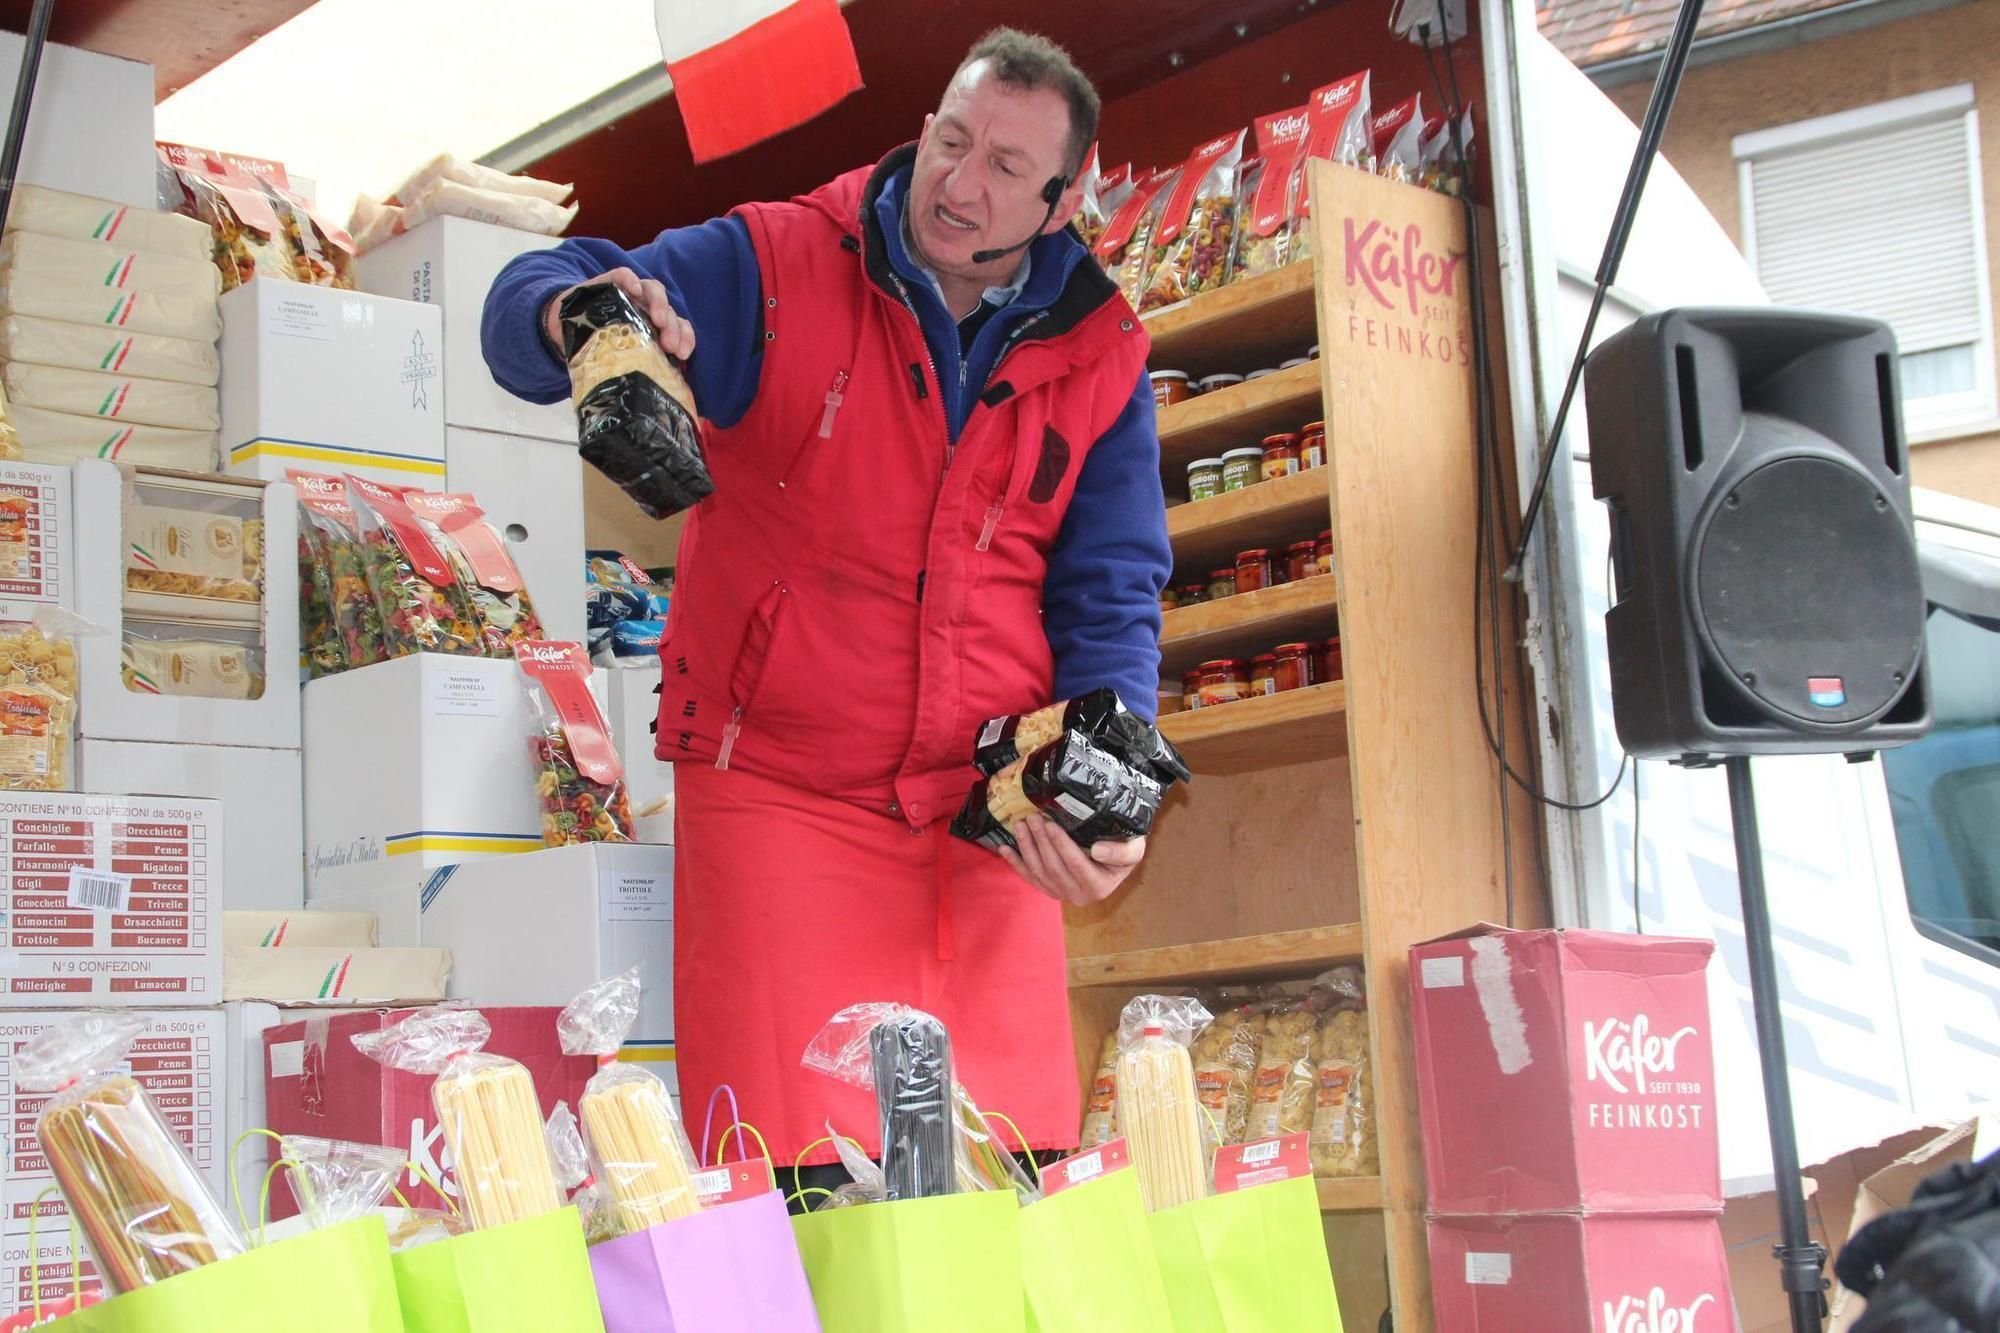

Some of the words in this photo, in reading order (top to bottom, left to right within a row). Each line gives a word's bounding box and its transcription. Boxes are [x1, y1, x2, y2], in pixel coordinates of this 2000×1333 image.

[1344, 216, 1469, 317] Käfer
[1425, 305, 1450, 322] SEIT
[1349, 315, 1470, 367] FEINKOS
[0, 583, 37, 593] ucaneve
[532, 645, 567, 664] Käfer
[0, 802, 54, 815] CONTIENE
[85, 806, 150, 818] CONFEZIONI
[153, 808, 165, 818] da
[16, 822, 72, 835] Conchiglie
[127, 826, 183, 837] Orecchiette
[16, 841, 57, 851] Farfalle
[154, 845, 183, 855] Penne
[142, 862, 183, 874] Rigatoni
[16, 878, 42, 890] Gigli
[152, 881, 184, 891] Trecce
[16, 898, 65, 908] Gnocchetti
[147, 900, 184, 909] Trivelle
[16, 916, 67, 927] Limoncini
[124, 917, 183, 927] Orsacchiotti
[16, 935, 60, 945] Trottole
[137, 935, 183, 945] Bucaneve
[79, 961, 152, 972] CONFEZIONI
[15, 980, 67, 992] Millerighe
[134, 980, 181, 990] Lumaconi
[0, 1024, 55, 1036] CONTIE
[155, 1022, 168, 1032] da
[1583, 1013, 1698, 1095] Käfer
[158, 1059, 187, 1069] Penne
[146, 1076, 188, 1089] Rigatoni
[1649, 1081, 1672, 1095] SEIT
[1675, 1081, 1702, 1095] 1930
[155, 1096, 188, 1105] Trecce
[1588, 1102, 1703, 1129] FEINKOST
